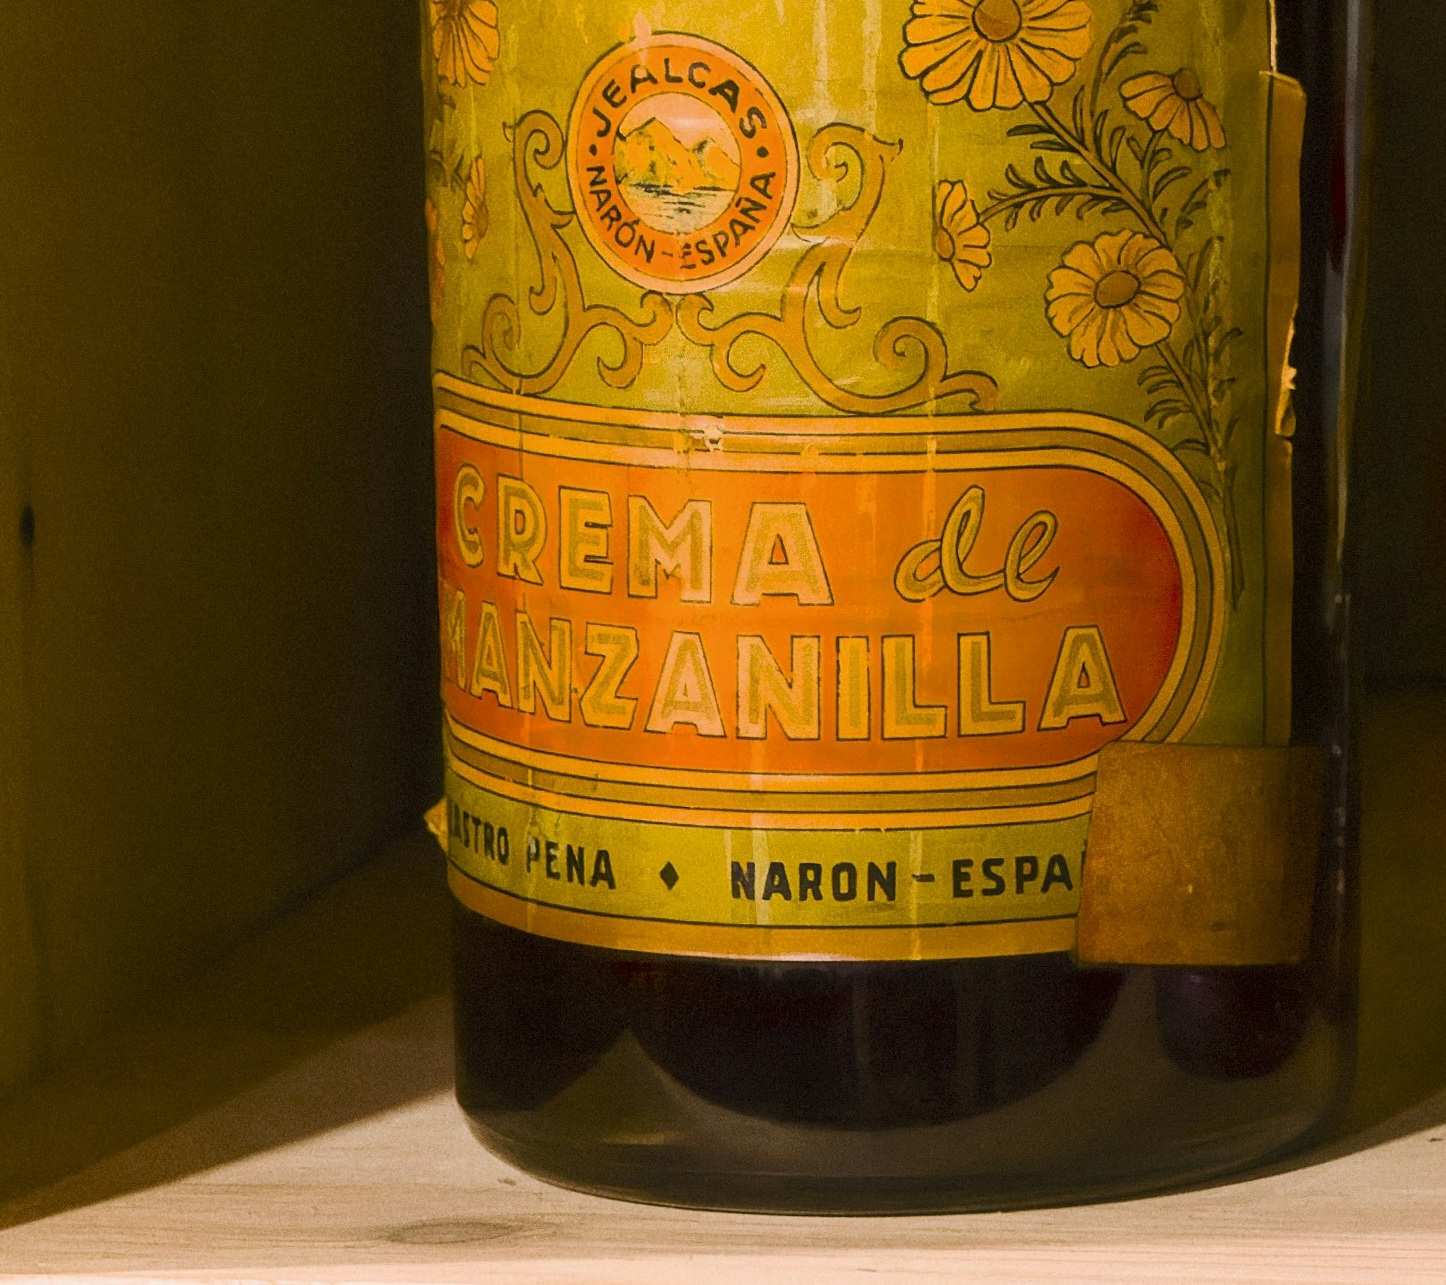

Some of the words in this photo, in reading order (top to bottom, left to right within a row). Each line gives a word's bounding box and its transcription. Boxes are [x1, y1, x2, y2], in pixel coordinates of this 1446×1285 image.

[591, 57, 769, 140] JEALCAS
[453, 462, 834, 607] CREMA
[894, 483, 1062, 603] de
[442, 584, 1131, 743] MANZANILLA
[449, 801, 510, 867] ASTRO
[525, 833, 618, 890] PENA
[730, 860, 898, 903] NARON
[950, 850, 1087, 900] ESPA
